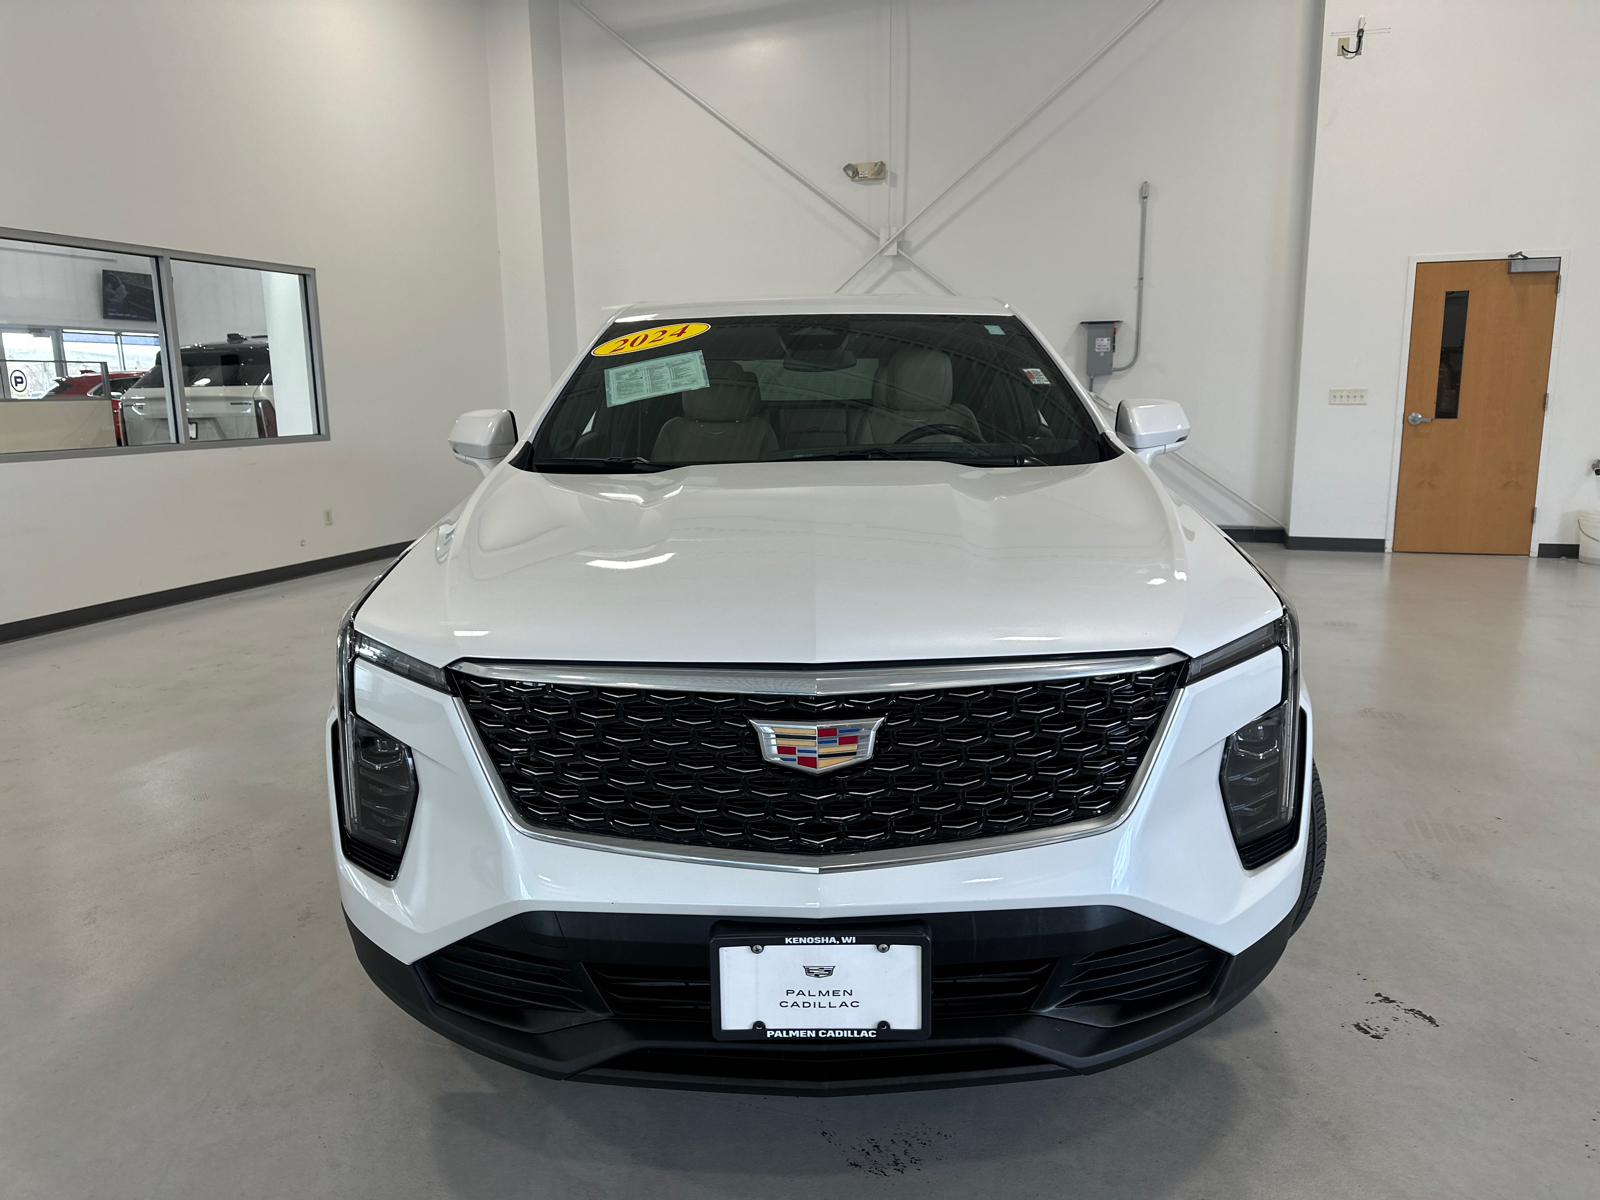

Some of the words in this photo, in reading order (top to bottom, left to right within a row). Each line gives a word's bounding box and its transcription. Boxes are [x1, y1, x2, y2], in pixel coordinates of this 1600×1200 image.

[609, 324, 690, 354] 2024
[14, 376, 24, 387] P
[841, 936, 856, 944] WI
[785, 989, 853, 997] PALMEN
[766, 1030, 817, 1038] PALMEN
[818, 1030, 877, 1038] CADILLAC
